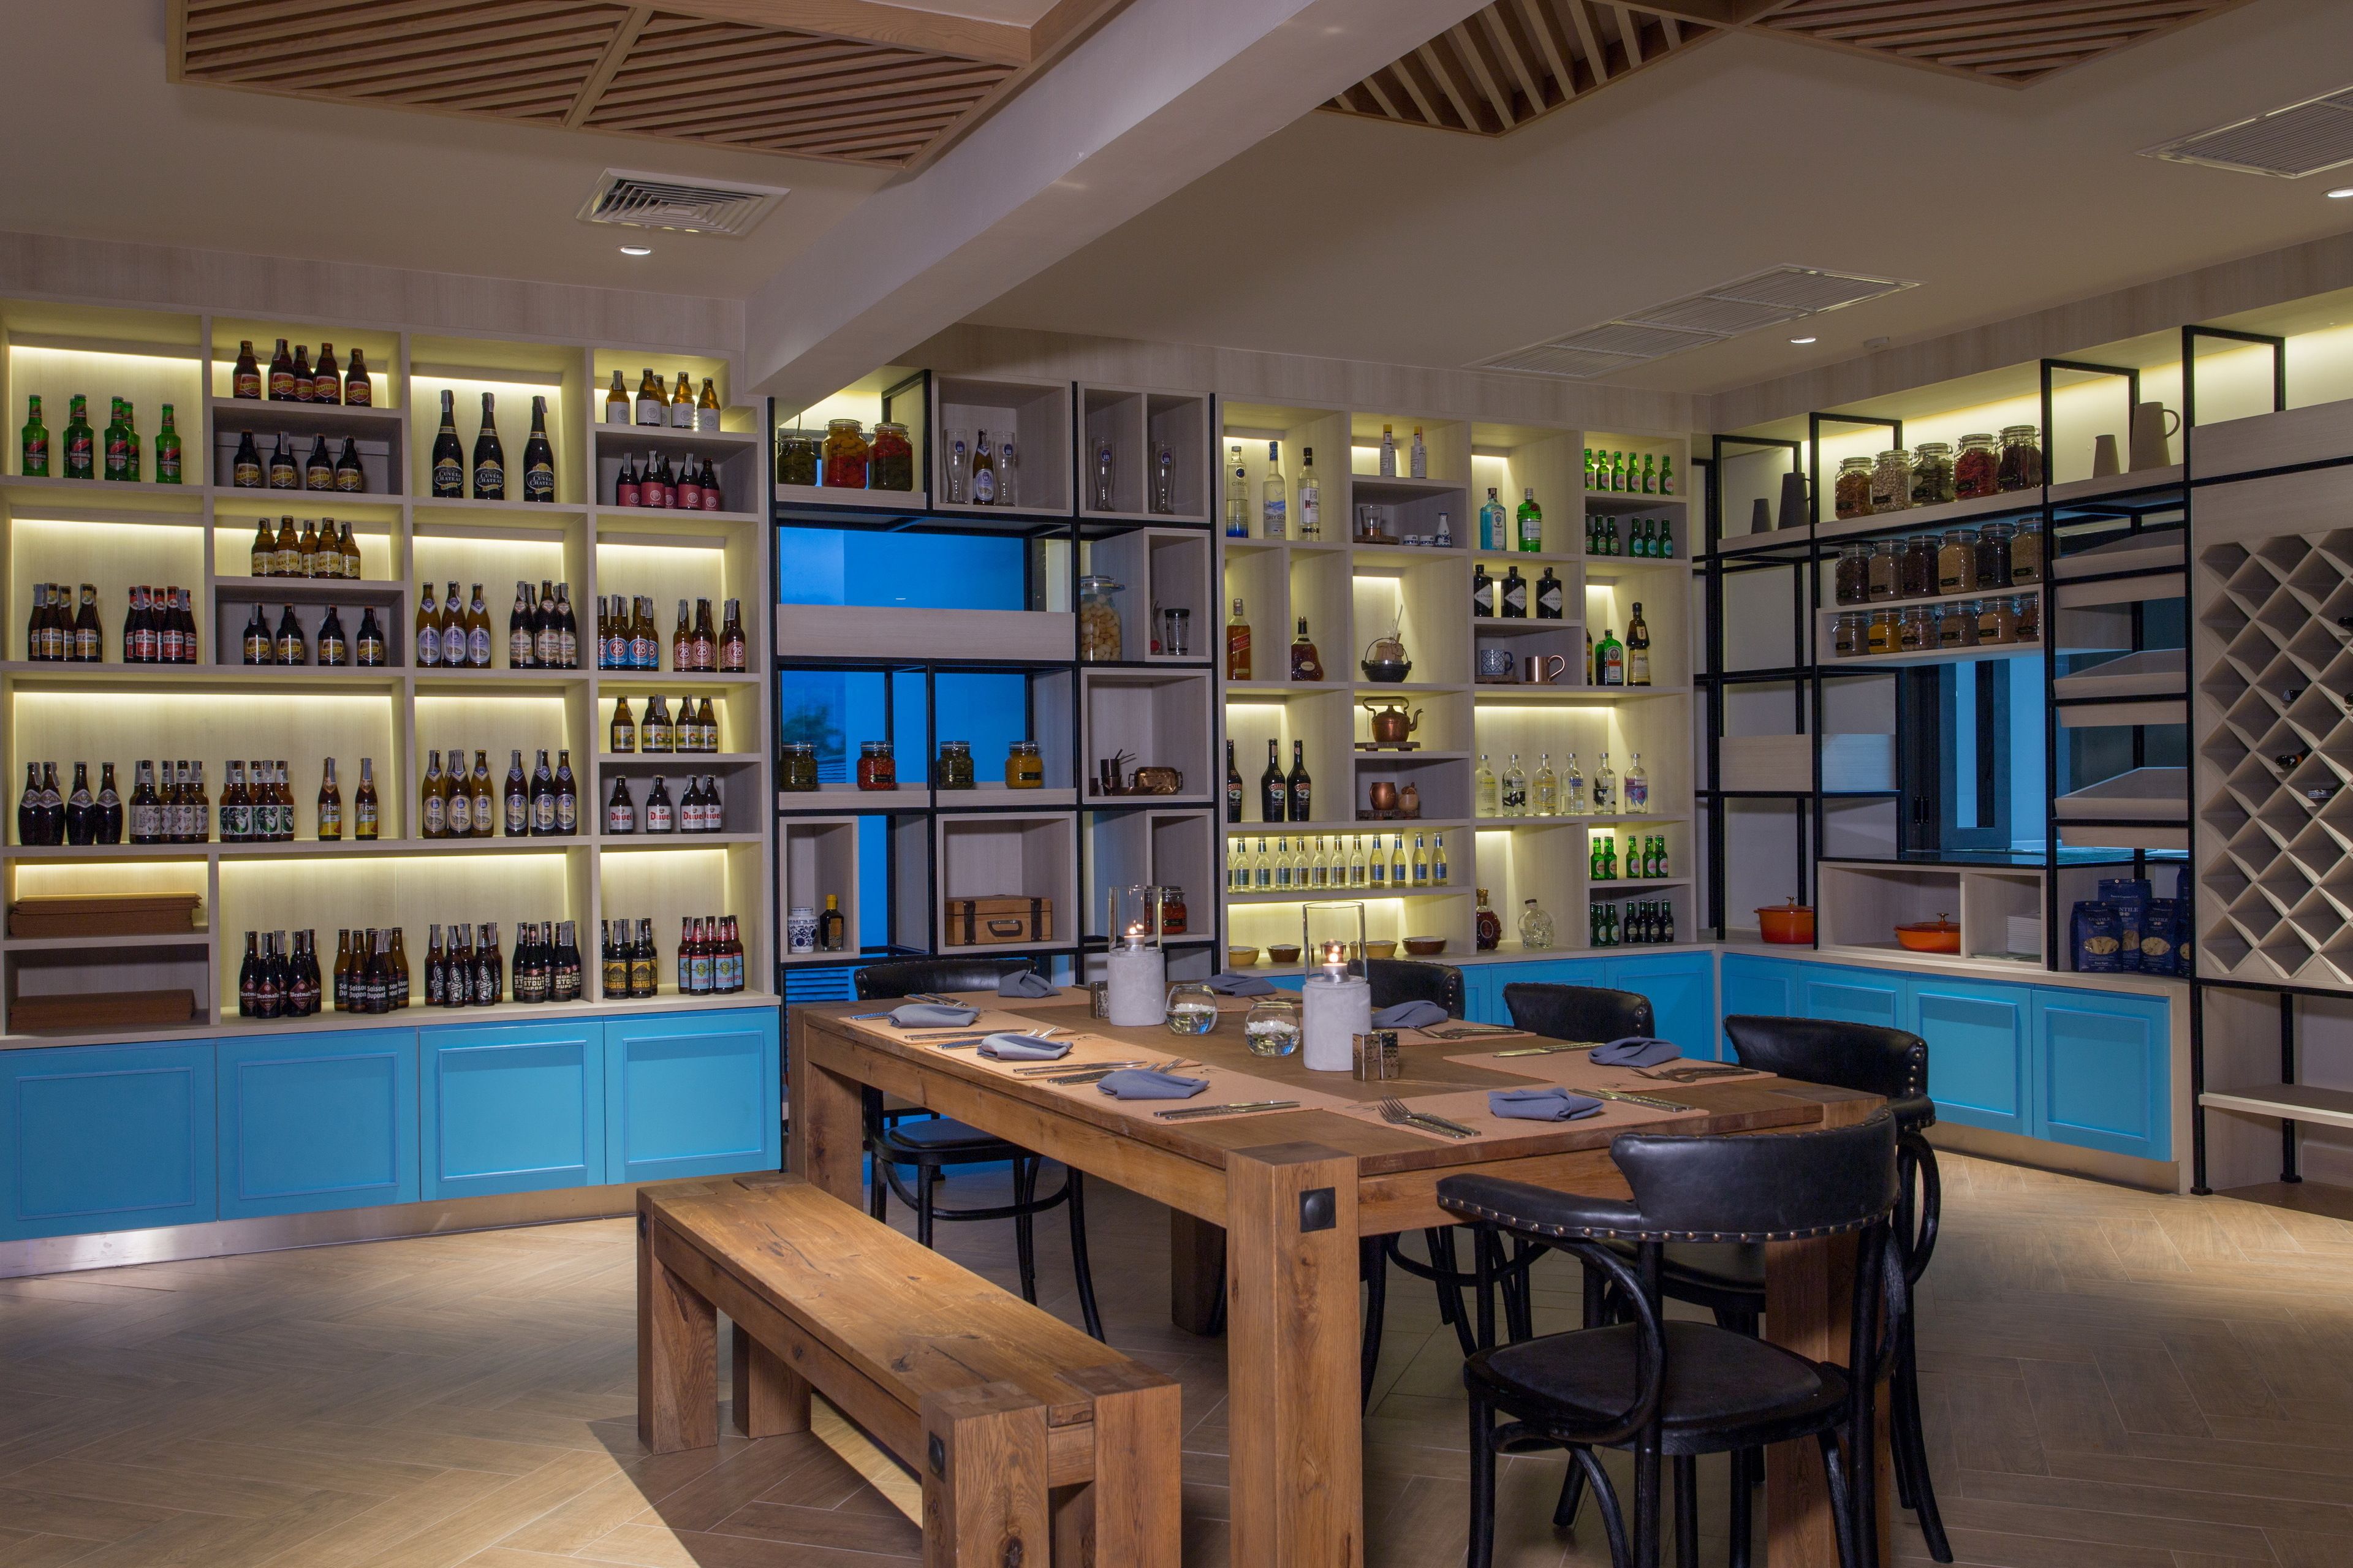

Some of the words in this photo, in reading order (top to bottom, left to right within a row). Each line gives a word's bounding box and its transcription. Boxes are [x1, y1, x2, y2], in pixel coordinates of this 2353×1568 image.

[613, 644, 623, 653] 28
[635, 644, 646, 654] 28
[679, 648, 689, 657] 28
[696, 645, 707, 654] 28
[732, 646, 741, 656] 28
[611, 811, 632, 820] Duvel
[650, 811, 672, 820] Duvel
[683, 811, 704, 820] Duvel
